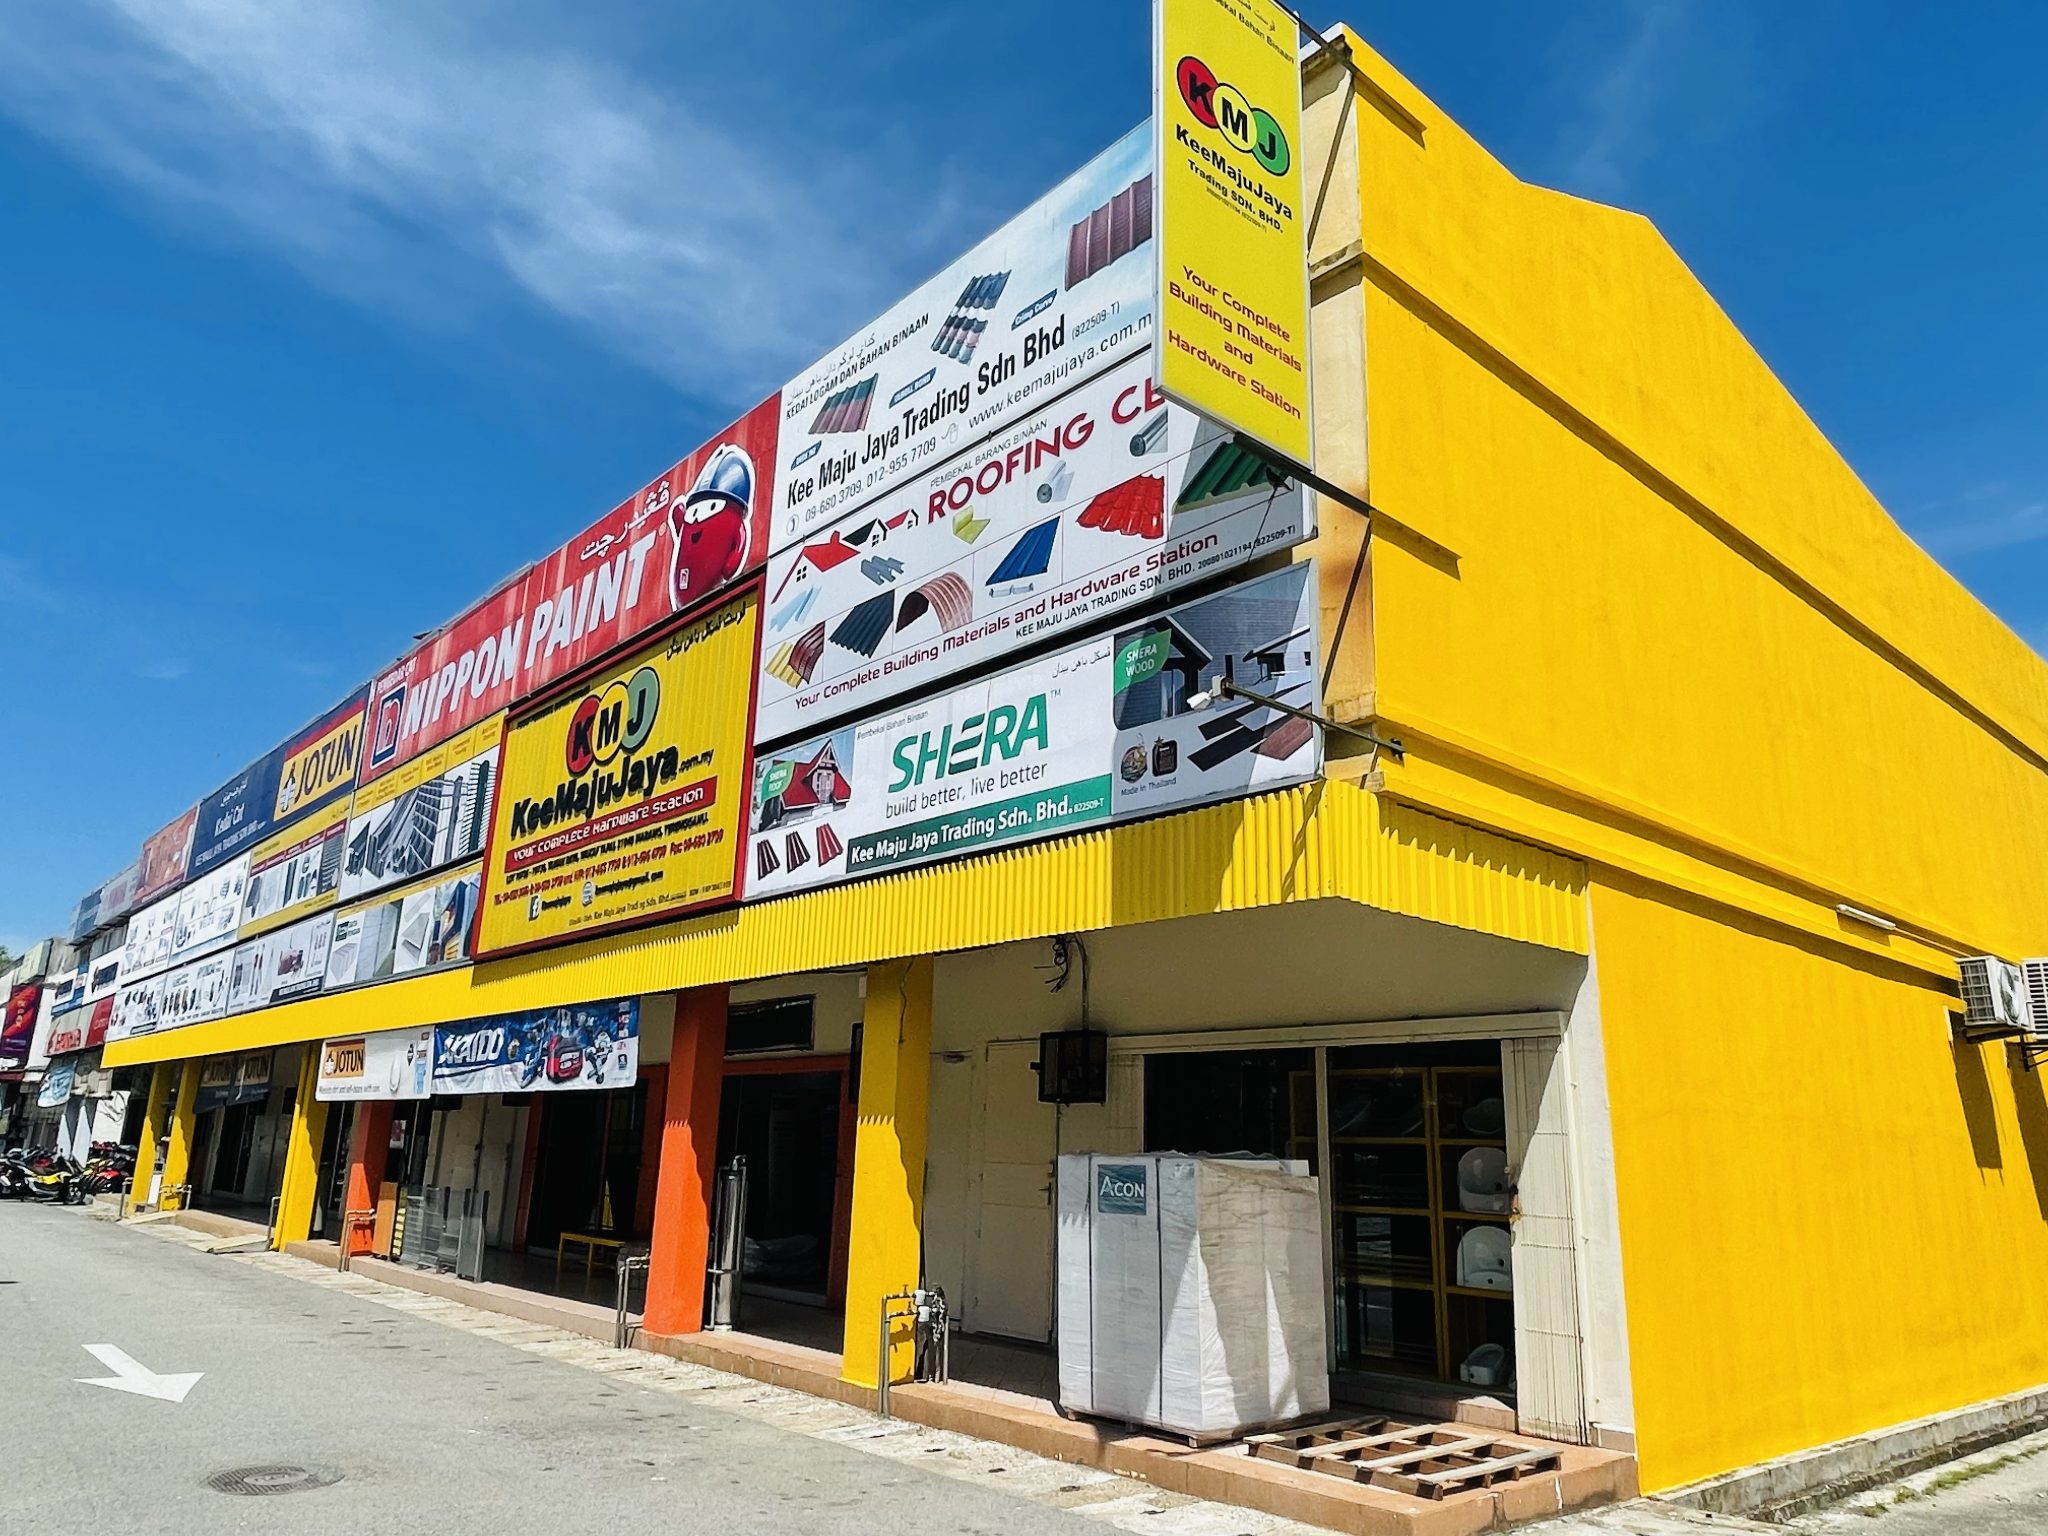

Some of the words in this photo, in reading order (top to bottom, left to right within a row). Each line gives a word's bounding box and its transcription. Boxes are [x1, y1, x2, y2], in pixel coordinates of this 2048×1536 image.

[1238, 12, 1265, 40] Bahan
[1266, 35, 1295, 64] Binaan
[1175, 123, 1293, 221] KeeMajuJaya
[1187, 158, 1229, 198] Trading
[1231, 189, 1256, 215] SDN.
[1258, 208, 1284, 234] BHD.
[1168, 280, 1233, 334] Building
[1237, 322, 1302, 372] Materials
[1182, 264, 1219, 297] Your
[1221, 291, 1291, 343] Complete
[786, 394, 809, 421] KEDAI
[808, 374, 838, 406] LOGAM
[839, 361, 858, 385] DAN
[859, 338, 891, 371] BAHAN
[892, 313, 930, 348] BINAAN
[1167, 329, 1247, 387] Hardware
[1249, 378, 1301, 420] Station
[1223, 340, 1254, 366] and
[787, 477, 814, 509] Kee
[818, 448, 857, 491] Maju
[861, 423, 900, 465] Jaya
[902, 381, 971, 440] Trading
[976, 351, 1016, 396] Sdn
[1023, 313, 1066, 369] Bhd
[1071, 299, 1121, 341] (822509-T)
[805, 493, 837, 523] 09-680
[866, 452, 908, 488] 012-955
[911, 436, 937, 464] 7709
[968, 312, 1153, 430] www.keemajujaya.com.m
[927, 412, 1096, 526] ROOFING
[929, 462, 975, 490] PEMBEKAL
[974, 437, 1012, 466] BARANG
[1012, 417, 1049, 446] BINAAN
[401, 613, 526, 742] NIPPON
[524, 529, 659, 671] PAINT
[794, 690, 821, 711] Your
[822, 665, 881, 701] Complete
[882, 645, 940, 676] Building
[942, 616, 1012, 654] Materials
[1013, 598, 1048, 624] and
[1050, 562, 1142, 612] Hardware
[1145, 531, 1220, 573] Station
[1014, 621, 1036, 641] KEE
[1036, 612, 1064, 636] MAJU
[1064, 602, 1090, 626] JAYA
[1090, 585, 1138, 615] TRADING
[1138, 573, 1167, 593] SDN.
[1167, 560, 1197, 583] BHD.
[1125, 643, 1159, 665] SHERA
[1125, 658, 1156, 678] WOOD
[294, 724, 359, 805] JOTUN
[887, 692, 1050, 795] SHERA
[885, 793, 918, 820] build
[920, 784, 967, 811] better,
[970, 773, 996, 797] live
[999, 760, 1049, 790] better
[1120, 785, 1139, 797] Made
[1148, 776, 1178, 791] Thailand
[850, 845, 875, 865] Kee
[875, 839, 908, 861] Maju
[908, 832, 939, 854] Jaya
[940, 816, 996, 842] Trading
[997, 809, 1034, 830] Sdn.
[1035, 794, 1074, 823] Bhd.
[333, 1048, 365, 1074] JOTUN
